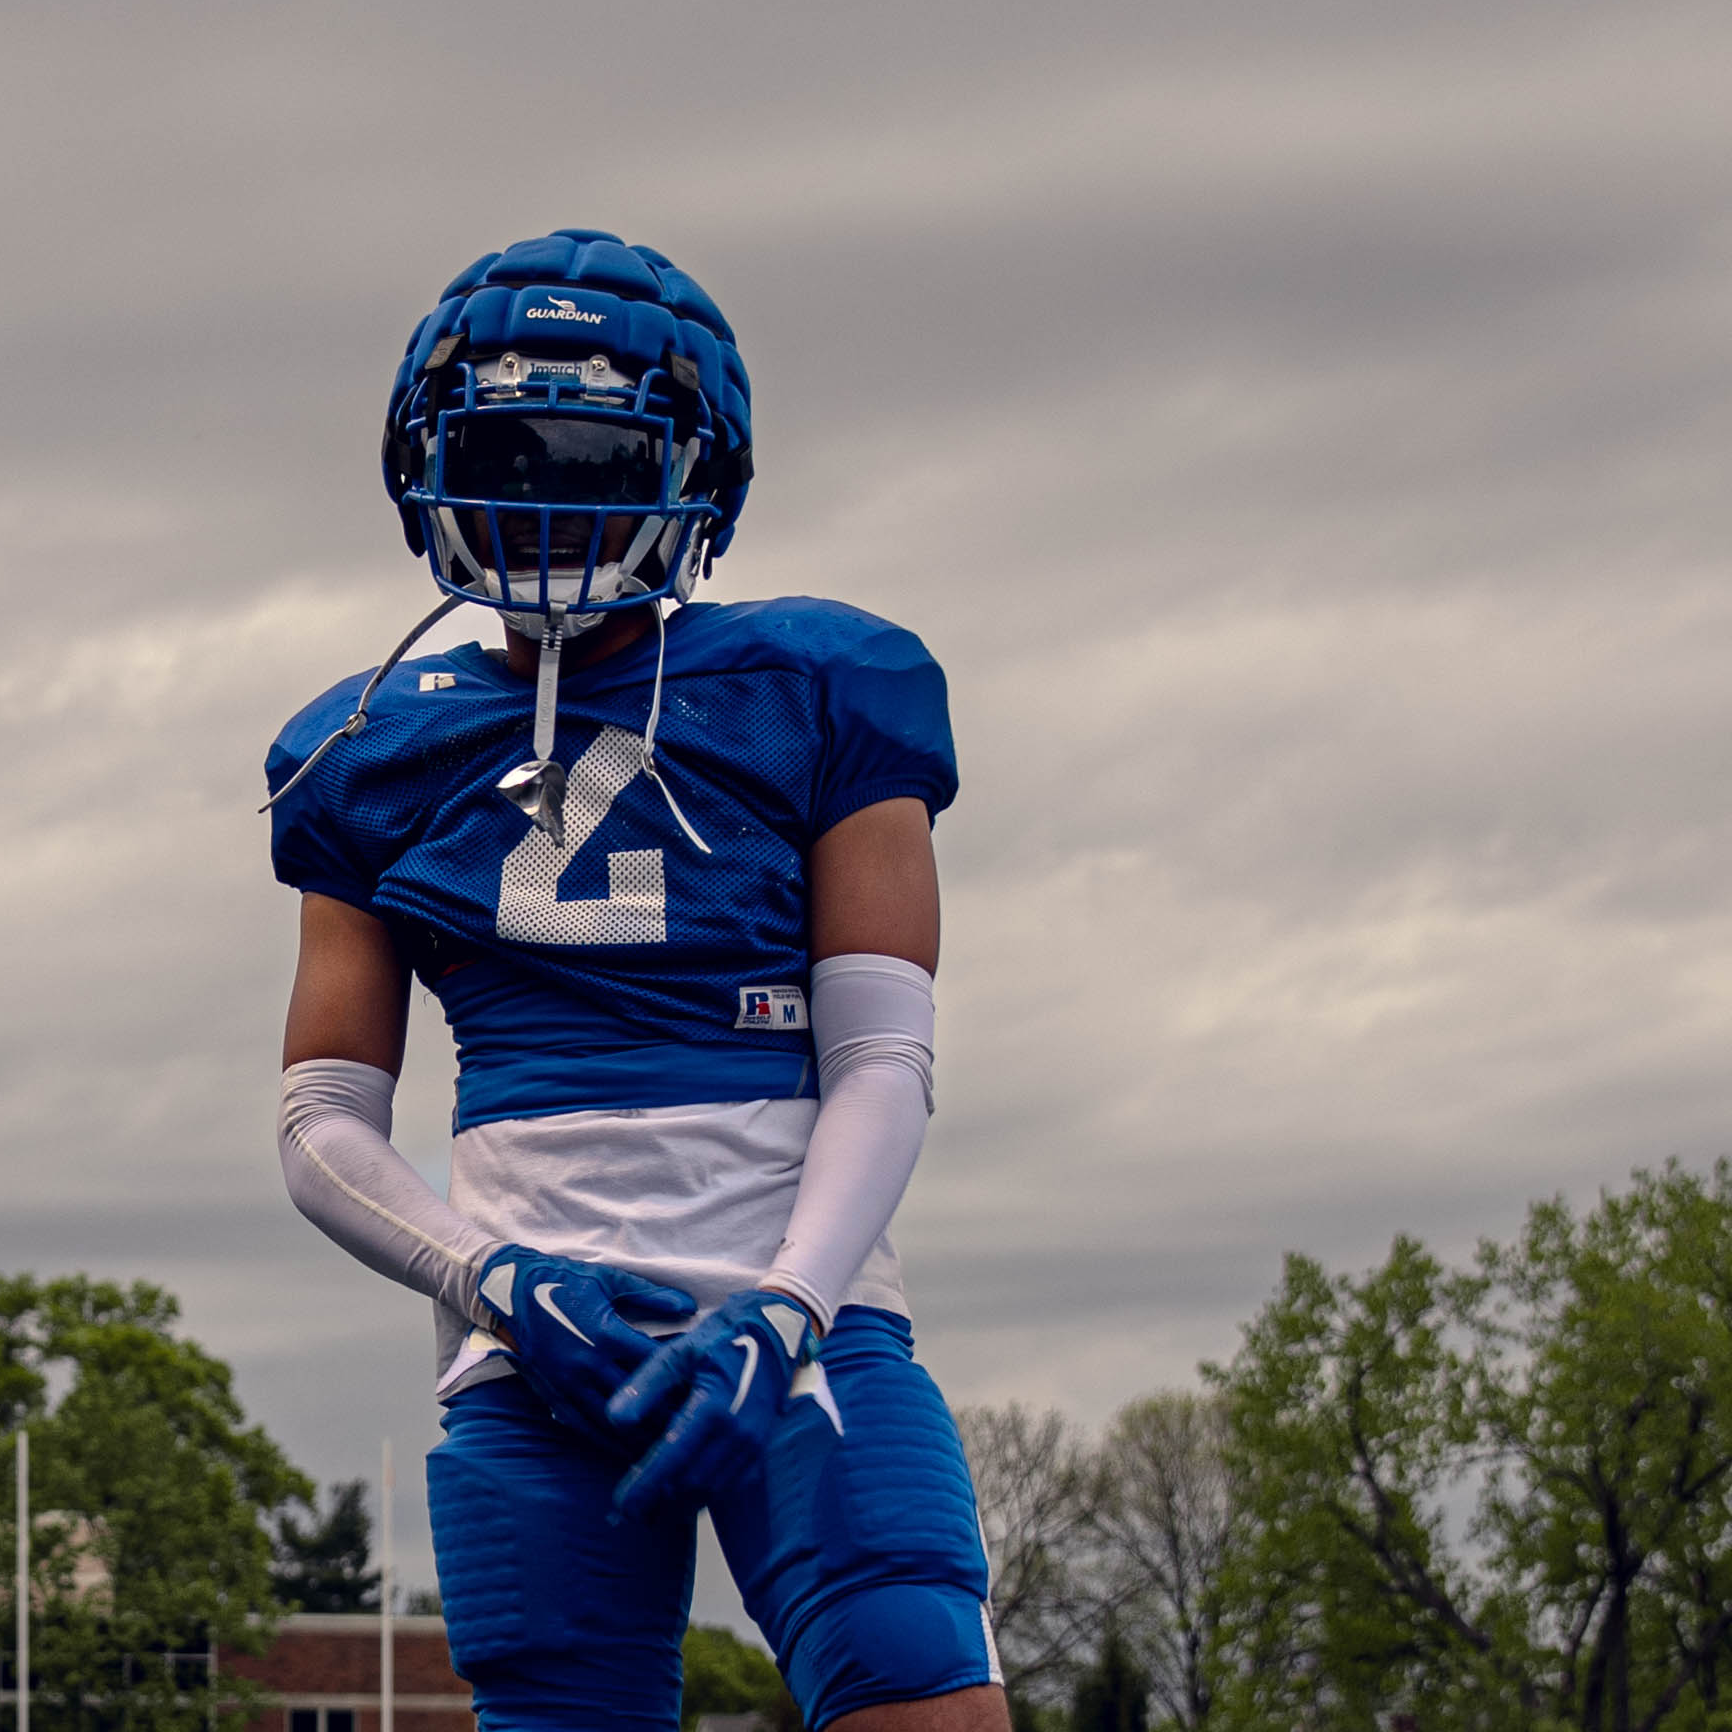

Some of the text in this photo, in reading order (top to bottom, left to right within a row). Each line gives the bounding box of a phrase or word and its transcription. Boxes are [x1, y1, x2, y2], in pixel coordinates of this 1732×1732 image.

[526, 308, 603, 325] GUARDIAN
[496, 724, 667, 945] 2
[783, 1003, 797, 1024] M
